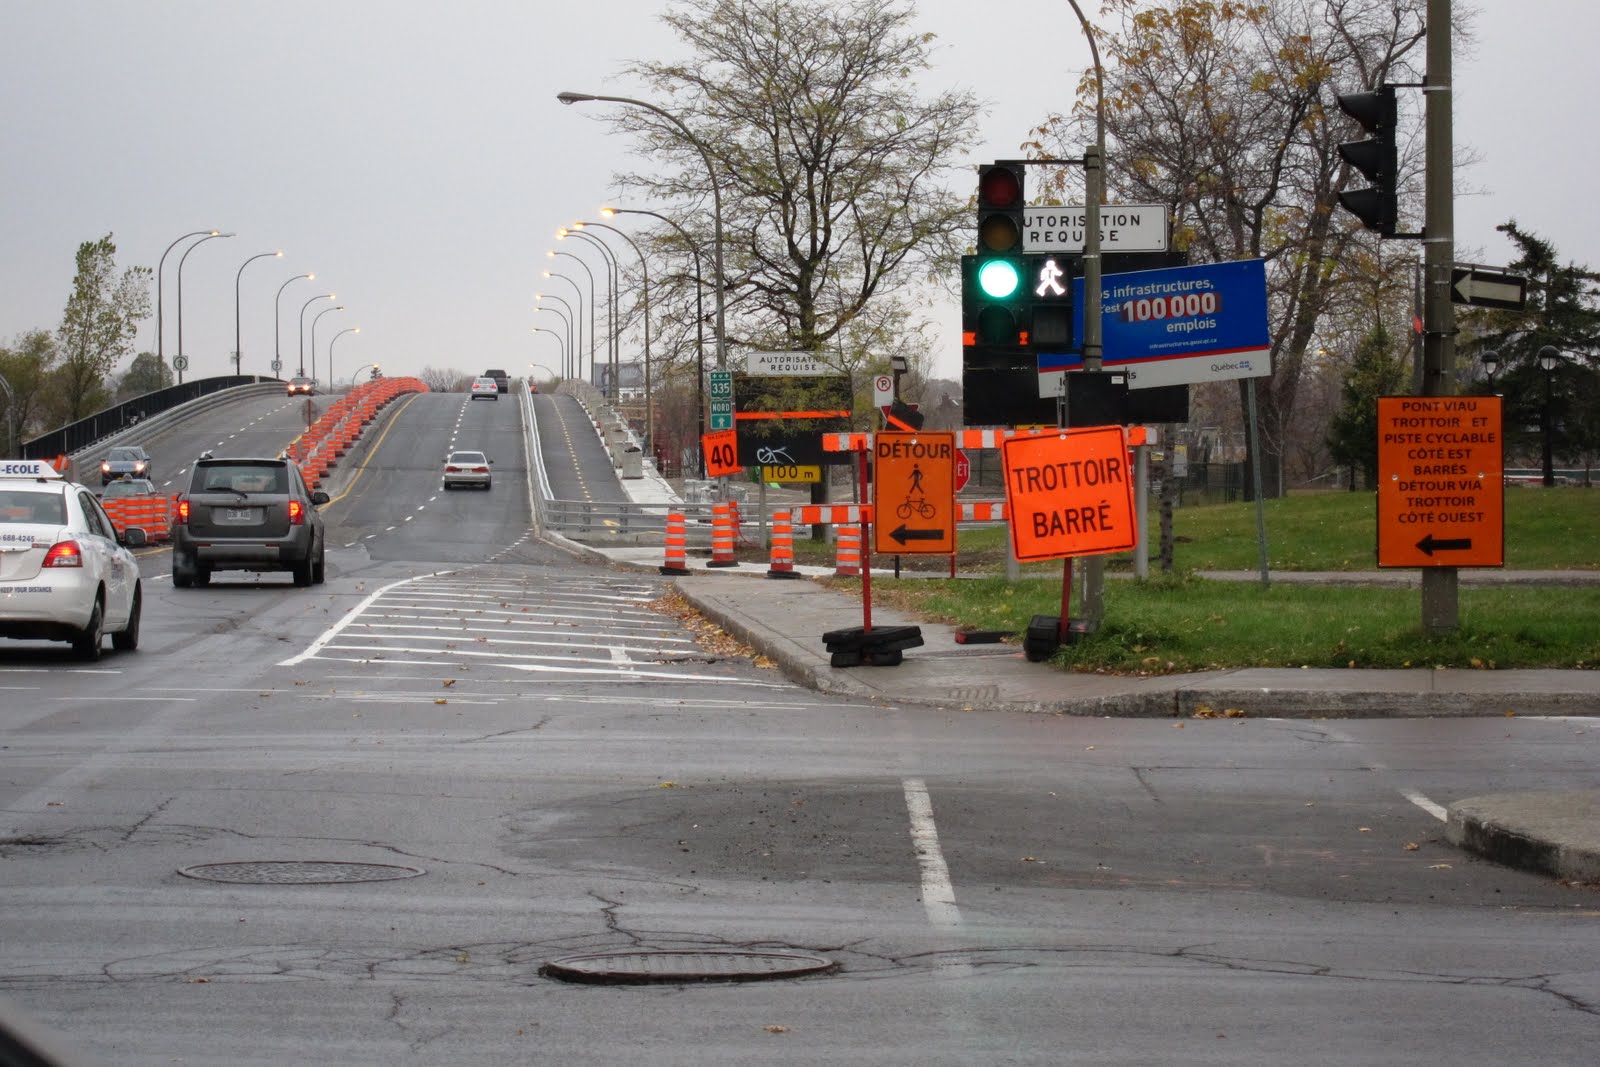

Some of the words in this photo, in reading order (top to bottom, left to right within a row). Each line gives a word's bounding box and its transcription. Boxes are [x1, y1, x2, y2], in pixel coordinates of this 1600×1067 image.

[1023, 214, 1140, 228] UTORISTION
[1030, 230, 1119, 243] REQUSE
[1113, 279, 1214, 298] infrastructures,
[1123, 297, 1167, 322] 100
[1170, 292, 1216, 317] 000
[1166, 317, 1217, 333] emplois
[759, 356, 821, 364] AUTORISATIO
[712, 383, 730, 394] 335
[712, 403, 730, 411] NORD
[1402, 401, 1440, 412] PONT
[1445, 401, 1477, 411] VIAU
[1392, 417, 1460, 428] TROTTOIR
[1471, 417, 1488, 427] ET
[1384, 433, 1422, 443] PISTE
[1426, 433, 1496, 443] CYCLABLE
[878, 440, 950, 459] DÉTOUR
[1408, 447, 1445, 459] CÔTÉ
[1448, 449, 1472, 459] EST
[711, 444, 734, 469] 40
[770, 465, 798, 479] 100
[1413, 463, 1467, 475] BARRÉS
[1012, 457, 1122, 494] TROTTOIR
[1399, 479, 1456, 491] DÉTOUR
[1459, 480, 1482, 490] VIA
[1407, 497, 1475, 507] TROTTOIR
[1032, 500, 1114, 538] BARRÉ
[1398, 511, 1434, 523] CÔTÉ
[1438, 512, 1484, 523] OUEST
